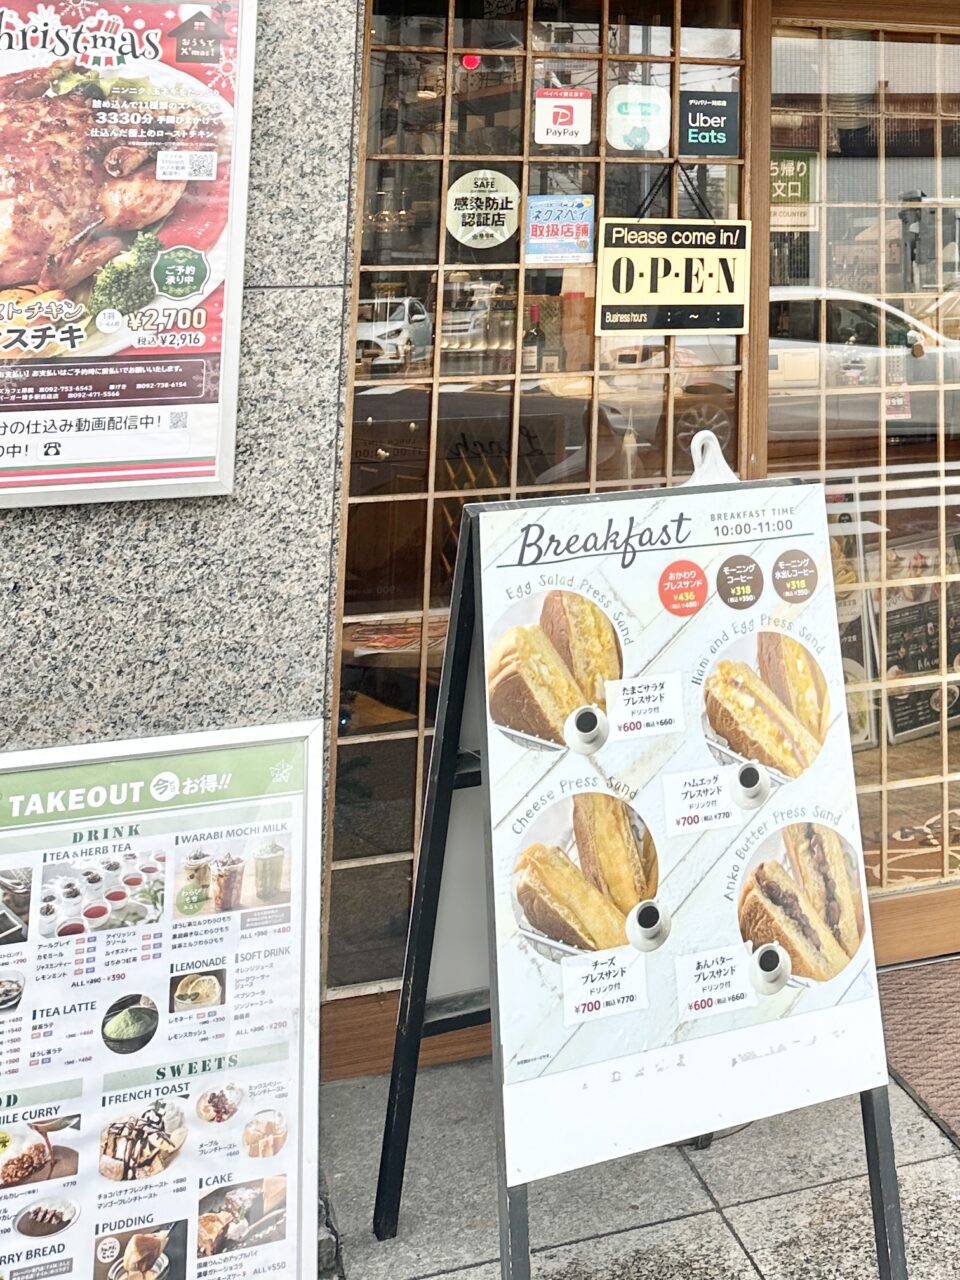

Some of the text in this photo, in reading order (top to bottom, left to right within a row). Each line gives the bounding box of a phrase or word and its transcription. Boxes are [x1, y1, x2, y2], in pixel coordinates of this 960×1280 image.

[96, 112, 153, 125] 3330分
[688, 112, 727, 128] Uber
[546, 128, 580, 138] PayPay
[688, 128, 727, 144] Eats
[474, 181, 495, 189] SAFE
[454, 196, 514, 211] 感染防止
[461, 212, 507, 227] 認証店
[532, 209, 588, 221] ネクスペイ
[779, 210, 809, 219] COUNTER
[530, 223, 590, 238] 取扱店舗
[612, 227, 740, 246] Please come in!
[165, 265, 196, 276] ご予約
[128, 307, 207, 332] ¥2,700
[137, 333, 201, 347] 税込 ¥2,916
[710, 506, 795, 522] BREAKFAST TIME
[713, 519, 794, 537] 10:00-11:00
[517, 512, 693, 569] Breakfast
[723, 563, 756, 573] モーニング
[778, 558, 810, 570] モーニング
[668, 570, 697, 581] おかわり
[727, 574, 753, 584] コーヒー
[775, 570, 815, 580] 水出しコーヒー
[664, 580, 703, 591] プレスサンド
[731, 585, 752, 596] ¥318
[786, 580, 806, 590] ¥318
[673, 593, 695, 602] ¥436
[505, 573, 634, 646] Egg Salad Press Sand
[691, 613, 826, 686] Ham and Egg Press Sand
[622, 681, 666, 696] たまごサラダ
[623, 693, 665, 706] プレスサンド
[630, 706, 660, 716] ドリンク付
[617, 721, 642, 732] ¥600
[683, 775, 719, 788] ハムエッグ
[9, 781, 145, 817] TAKEOUT
[681, 785, 722, 800] プレスサンド
[512, 776, 639, 835] Cheese Press Sand
[688, 799, 717, 810] ドリンク付
[675, 814, 700, 827] ¥700
[72, 824, 141, 844] DRINK
[181, 822, 288, 845] WARABI MOCHI MILK
[50, 850, 70, 861] TEA
[80, 846, 110, 858] HERB
[112, 843, 132, 855] TEA
[724, 805, 842, 902] Anko Butter Press Sand
[240, 946, 291, 963] SOFT DRINK
[175, 956, 227, 972] LEMONADE
[592, 956, 616, 971] チーズ
[696, 956, 734, 971] あんバター
[35, 972, 68, 982] レモンミント
[582, 966, 627, 985] プレスサンド
[694, 966, 736, 983] プレスサンド
[71, 980, 85, 988] ALL
[589, 982, 621, 996] ドリンク付
[702, 981, 731, 993] ドリンク付
[39, 1001, 96, 1019] TEA LATTE
[574, 1000, 601, 1014] ¥700
[688, 997, 713, 1011] ¥600
[156, 1055, 238, 1081] SWEETS
[108, 1082, 191, 1106] FRENCH TOAST
[22, 1105, 61, 1121] CURRY
[205, 1173, 234, 1187] CAKE
[97, 1181, 169, 1201] チョコバナナフレンチトースト
[97, 1192, 158, 1209] マンゴーフレンチトースト
[102, 1214, 154, 1233] PUDDING
[26, 1243, 66, 1260] BREAD
